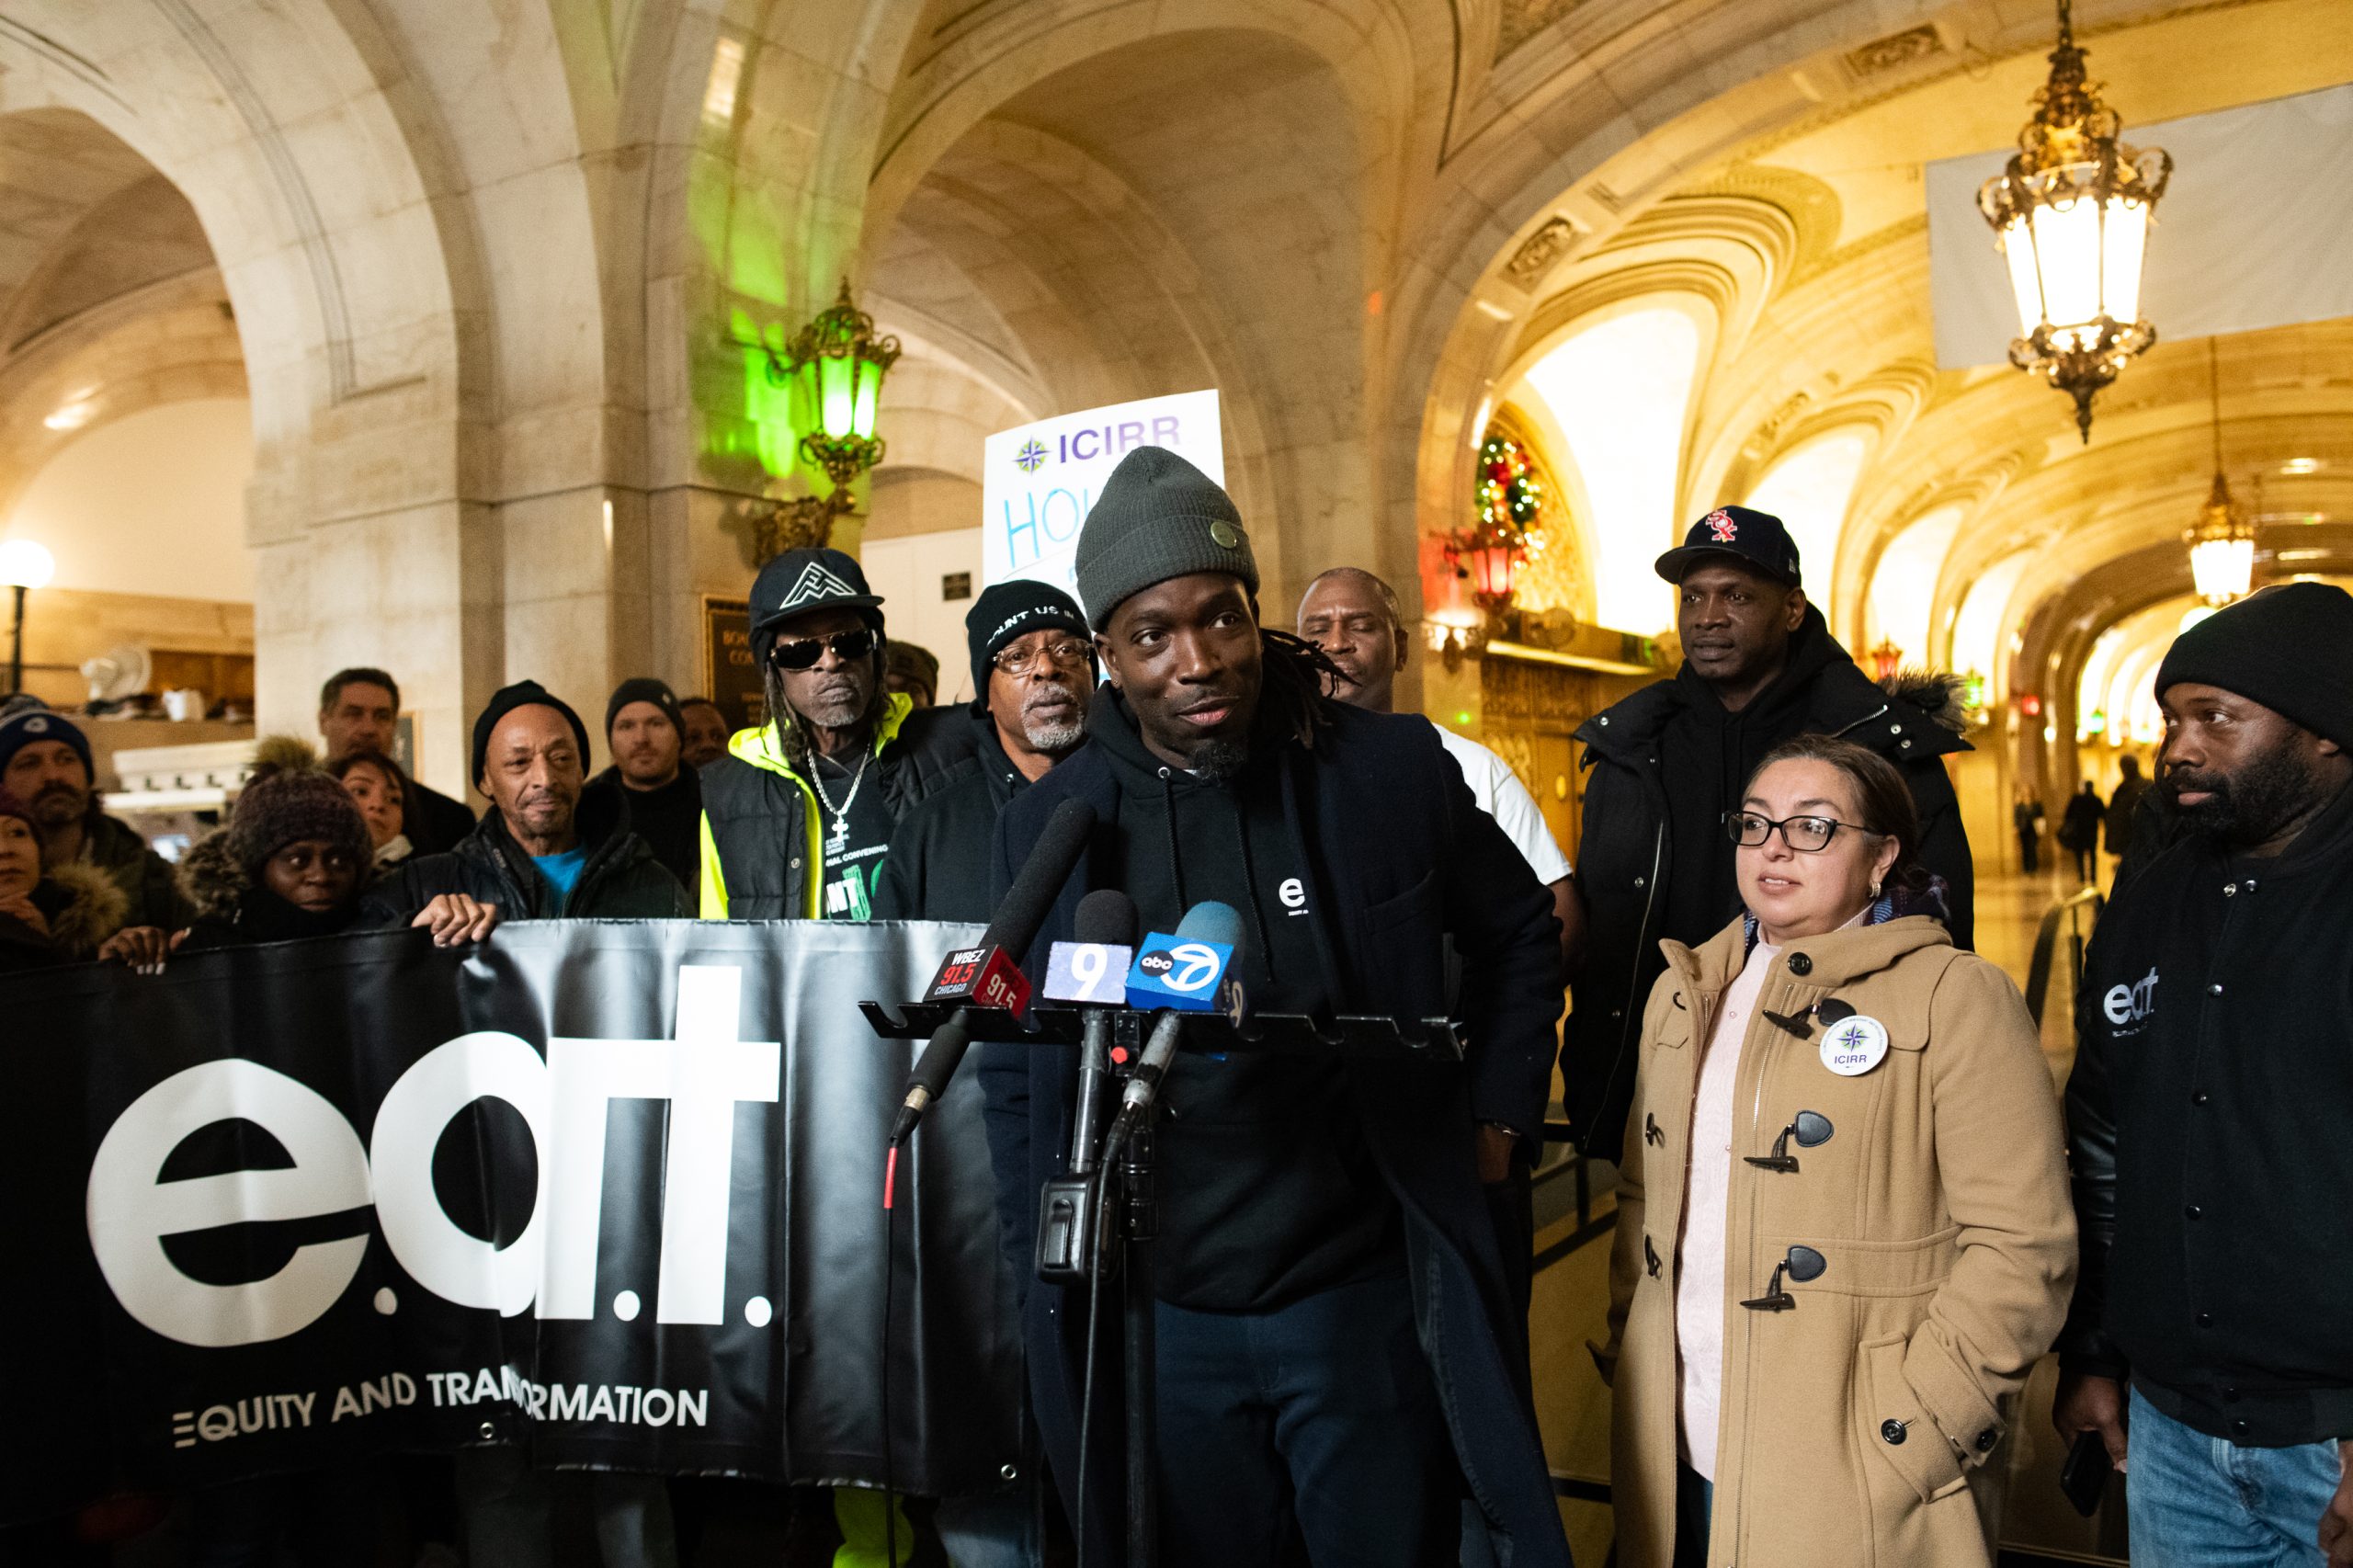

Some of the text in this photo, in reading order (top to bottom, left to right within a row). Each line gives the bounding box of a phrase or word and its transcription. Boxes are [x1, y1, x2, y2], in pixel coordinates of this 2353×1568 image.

[1059, 415, 1181, 464] ICIRR
[1705, 509, 1738, 542] SOX
[986, 610, 1029, 647] OUNT
[1034, 606, 1059, 615] US
[842, 844, 889, 862] CONVENING
[951, 949, 986, 966] WBEZ
[1071, 943, 1108, 1000] 9
[1141, 956, 1173, 971] abc
[940, 963, 977, 986] 91.5
[934, 983, 968, 995] CHICAGO
[986, 973, 1017, 1010] 91.5
[1834, 1054, 1868, 1064] ICIRR
[172, 1365, 708, 1449] EQUITY AND TRANORMATION
